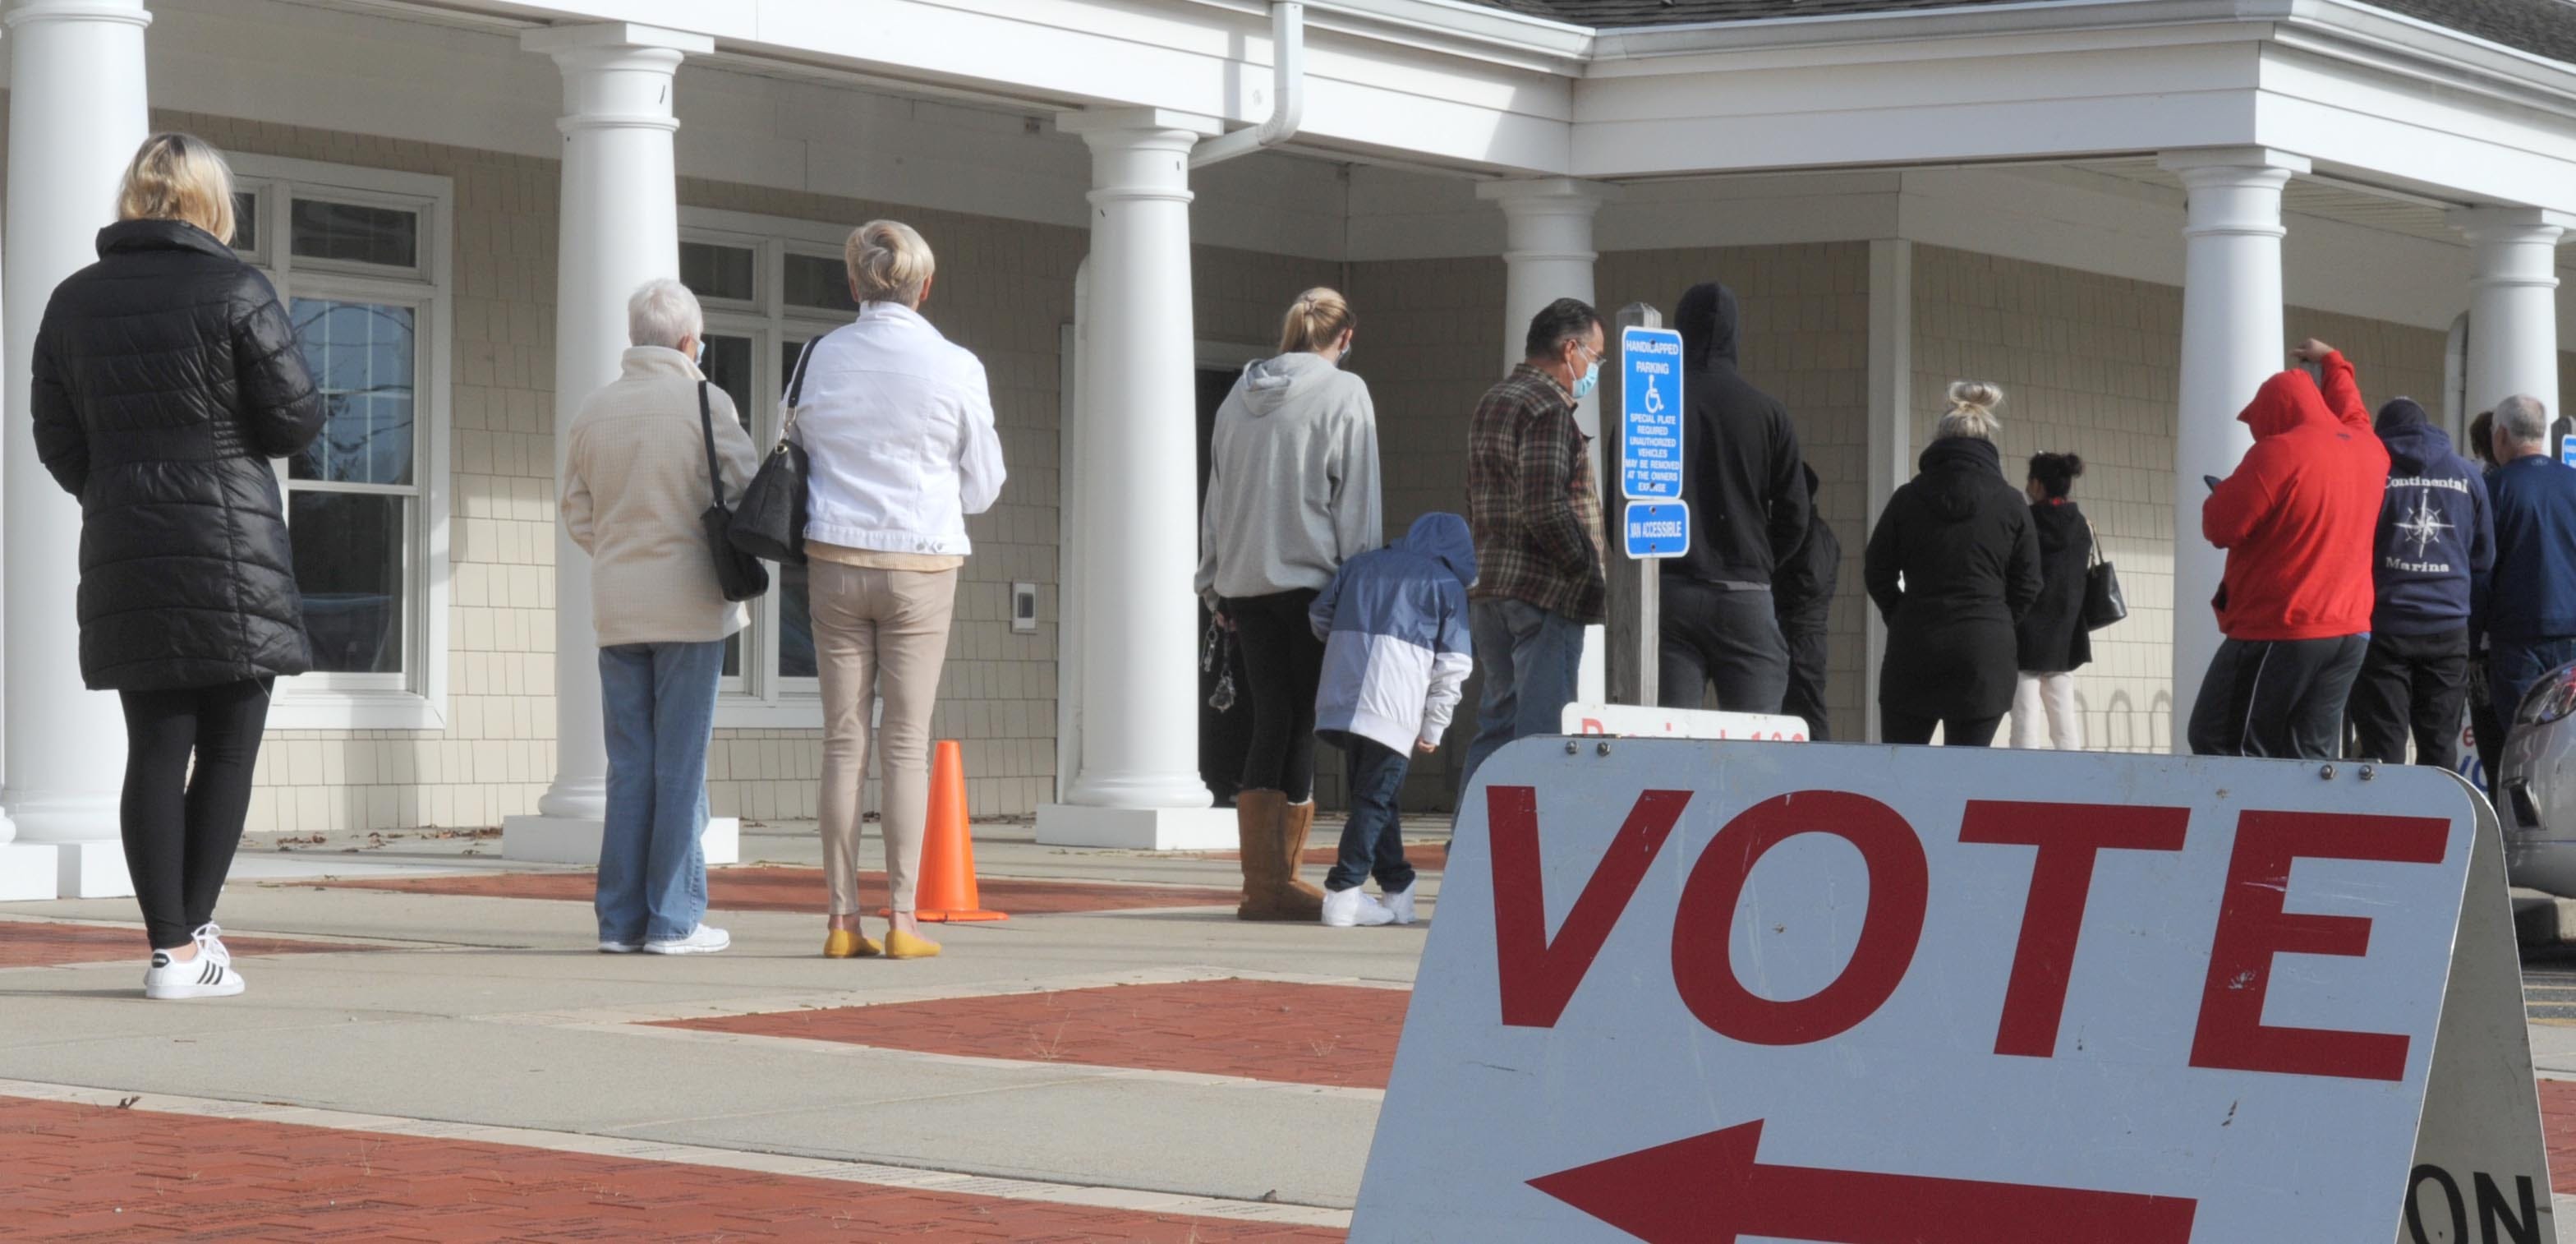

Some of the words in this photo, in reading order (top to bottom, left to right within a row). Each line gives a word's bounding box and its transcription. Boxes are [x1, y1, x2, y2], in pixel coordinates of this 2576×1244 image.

[1636, 361, 1669, 375] PARKING
[1630, 413, 1656, 424] SPECIAL
[1657, 415, 1676, 425] PLATE
[1637, 425, 1668, 435] REQUIRED
[1629, 436, 1677, 448] UNAUTHORIZED
[1638, 448, 1668, 458] VEHICLES
[1624, 458, 1638, 468] MAY
[1640, 459, 1649, 469] BE
[1650, 460, 1679, 471] REMOVED
[1626, 470, 1635, 479] AT
[1637, 471, 1649, 480] THE
[1651, 472, 1677, 481] OWNERS
[1643, 521, 1682, 537] ACCESSIBLE
[2385, 556, 2450, 573] Marina
[1487, 786, 2450, 1081] VOTE
